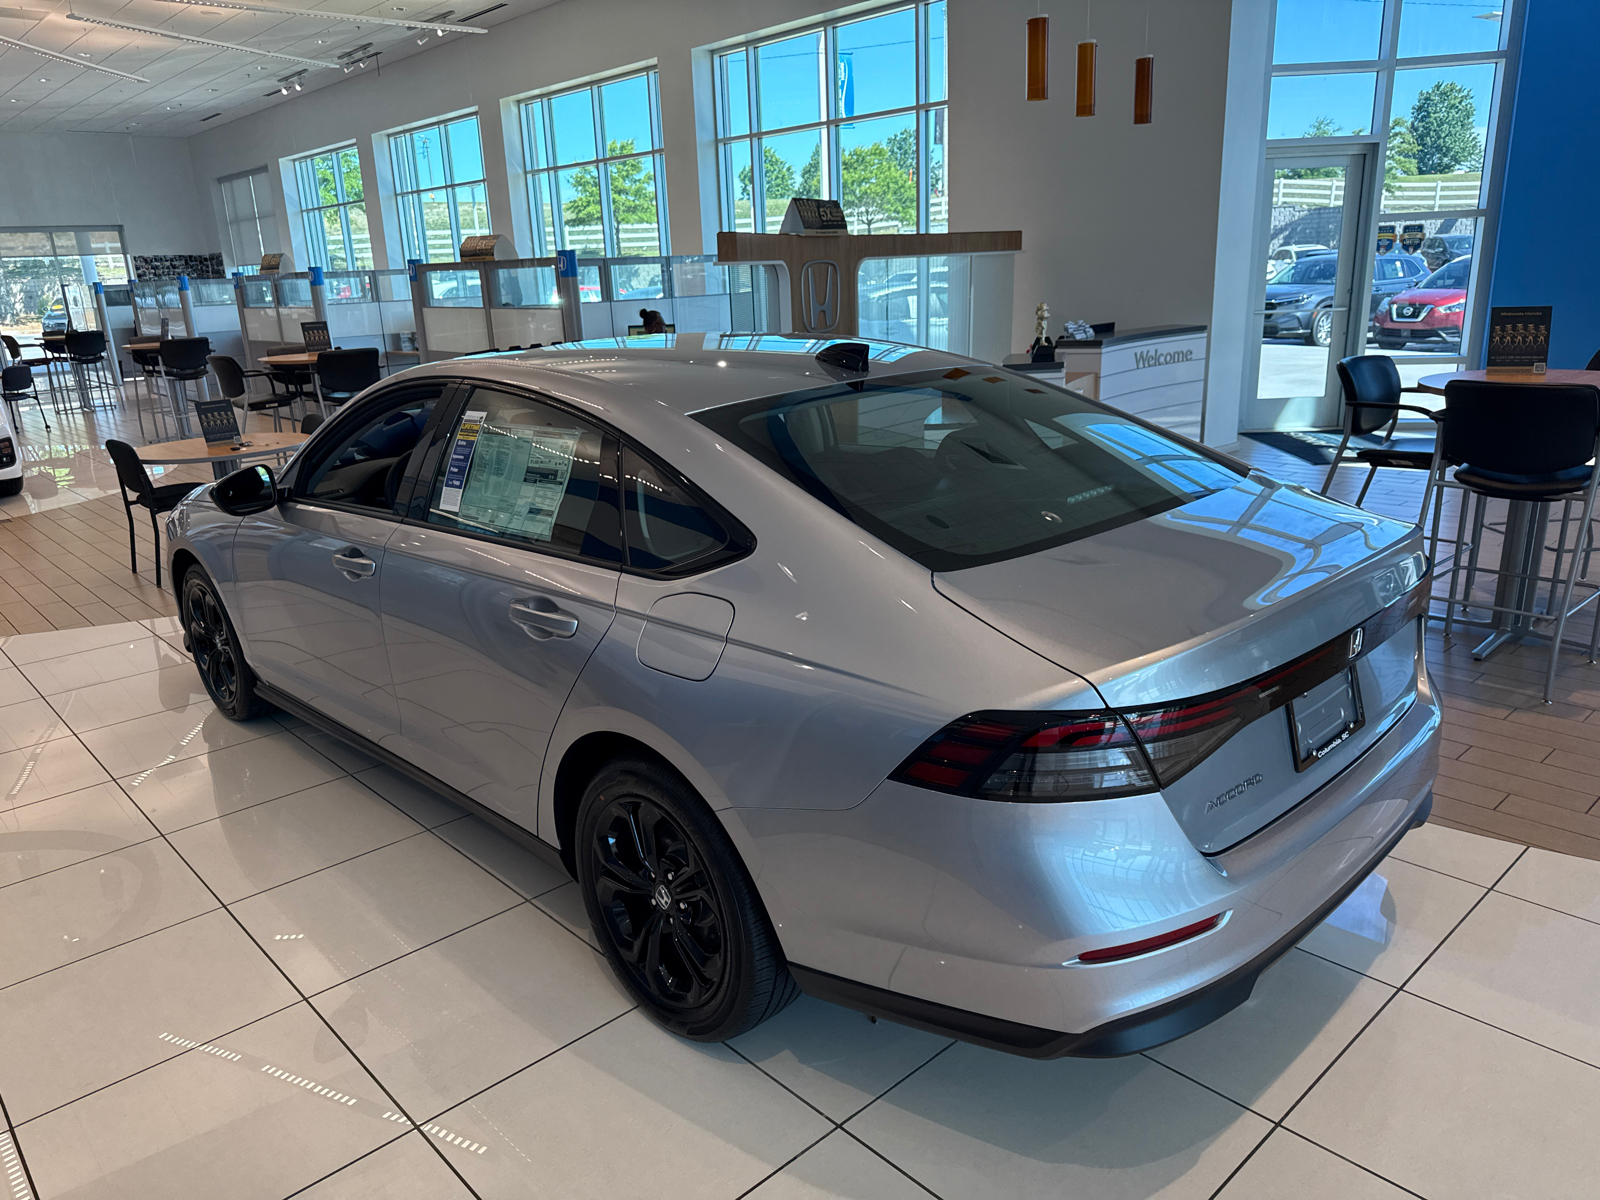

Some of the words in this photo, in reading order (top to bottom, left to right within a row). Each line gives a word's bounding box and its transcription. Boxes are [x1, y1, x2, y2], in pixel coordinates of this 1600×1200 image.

[1134, 348, 1193, 369] Welcome
[1318, 738, 1342, 758] Columbia
[1341, 731, 1350, 740] SC
[1205, 773, 1263, 814] ACCORD
